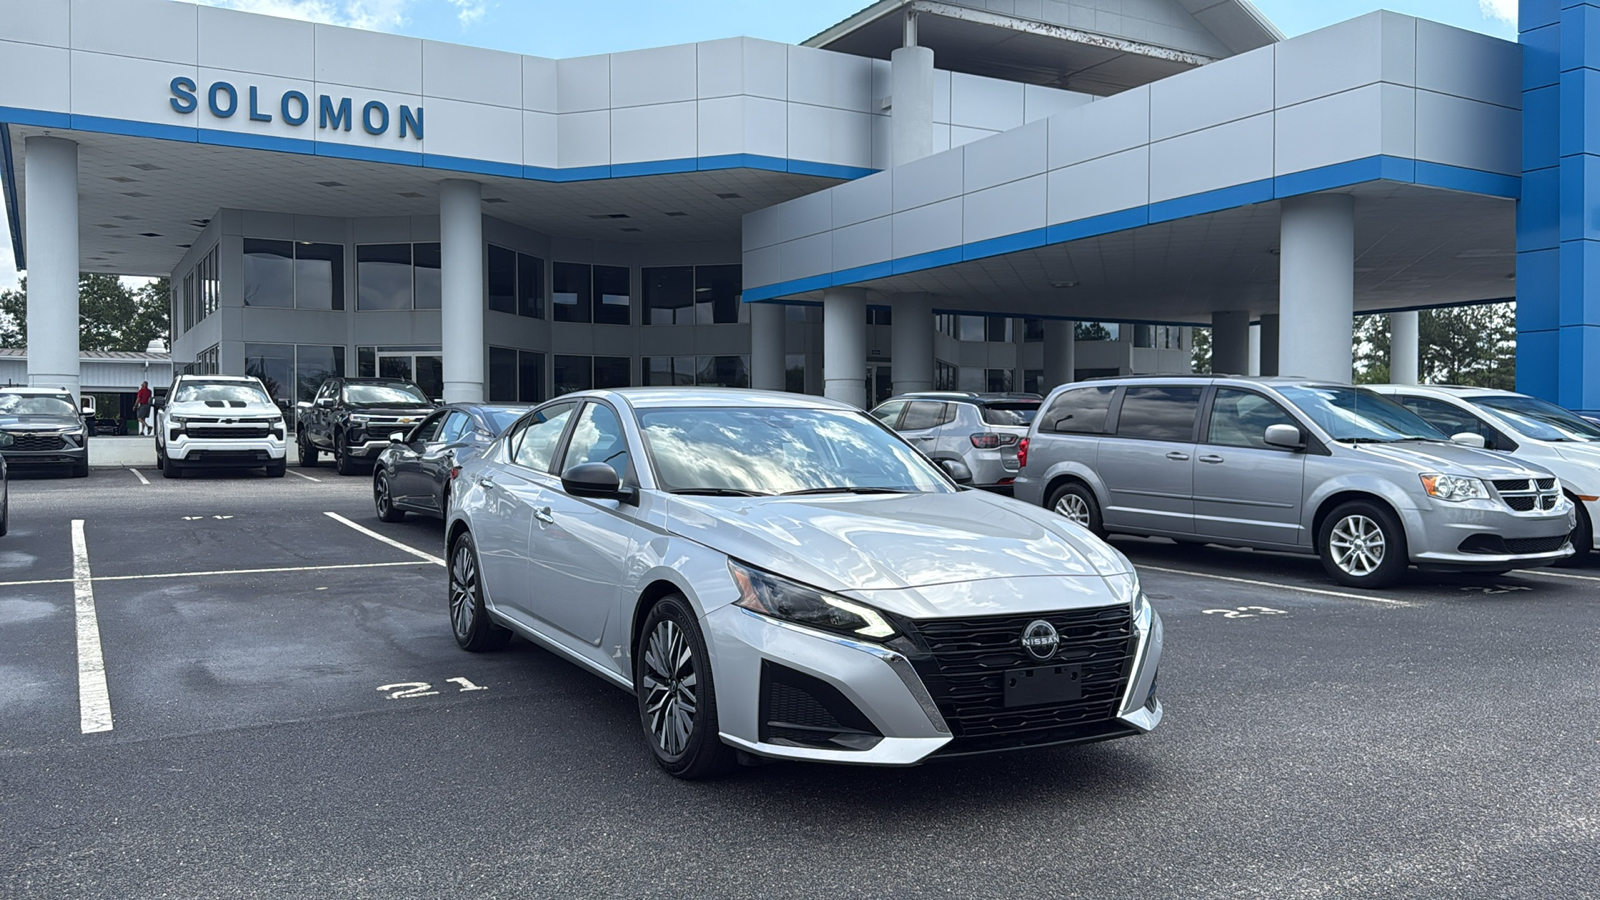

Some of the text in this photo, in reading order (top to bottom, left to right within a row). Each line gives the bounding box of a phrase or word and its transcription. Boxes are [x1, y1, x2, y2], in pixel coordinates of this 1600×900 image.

[169, 76, 424, 140] SOLOMON
[1022, 634, 1060, 646] NISSAN
[376, 677, 488, 699] 21
